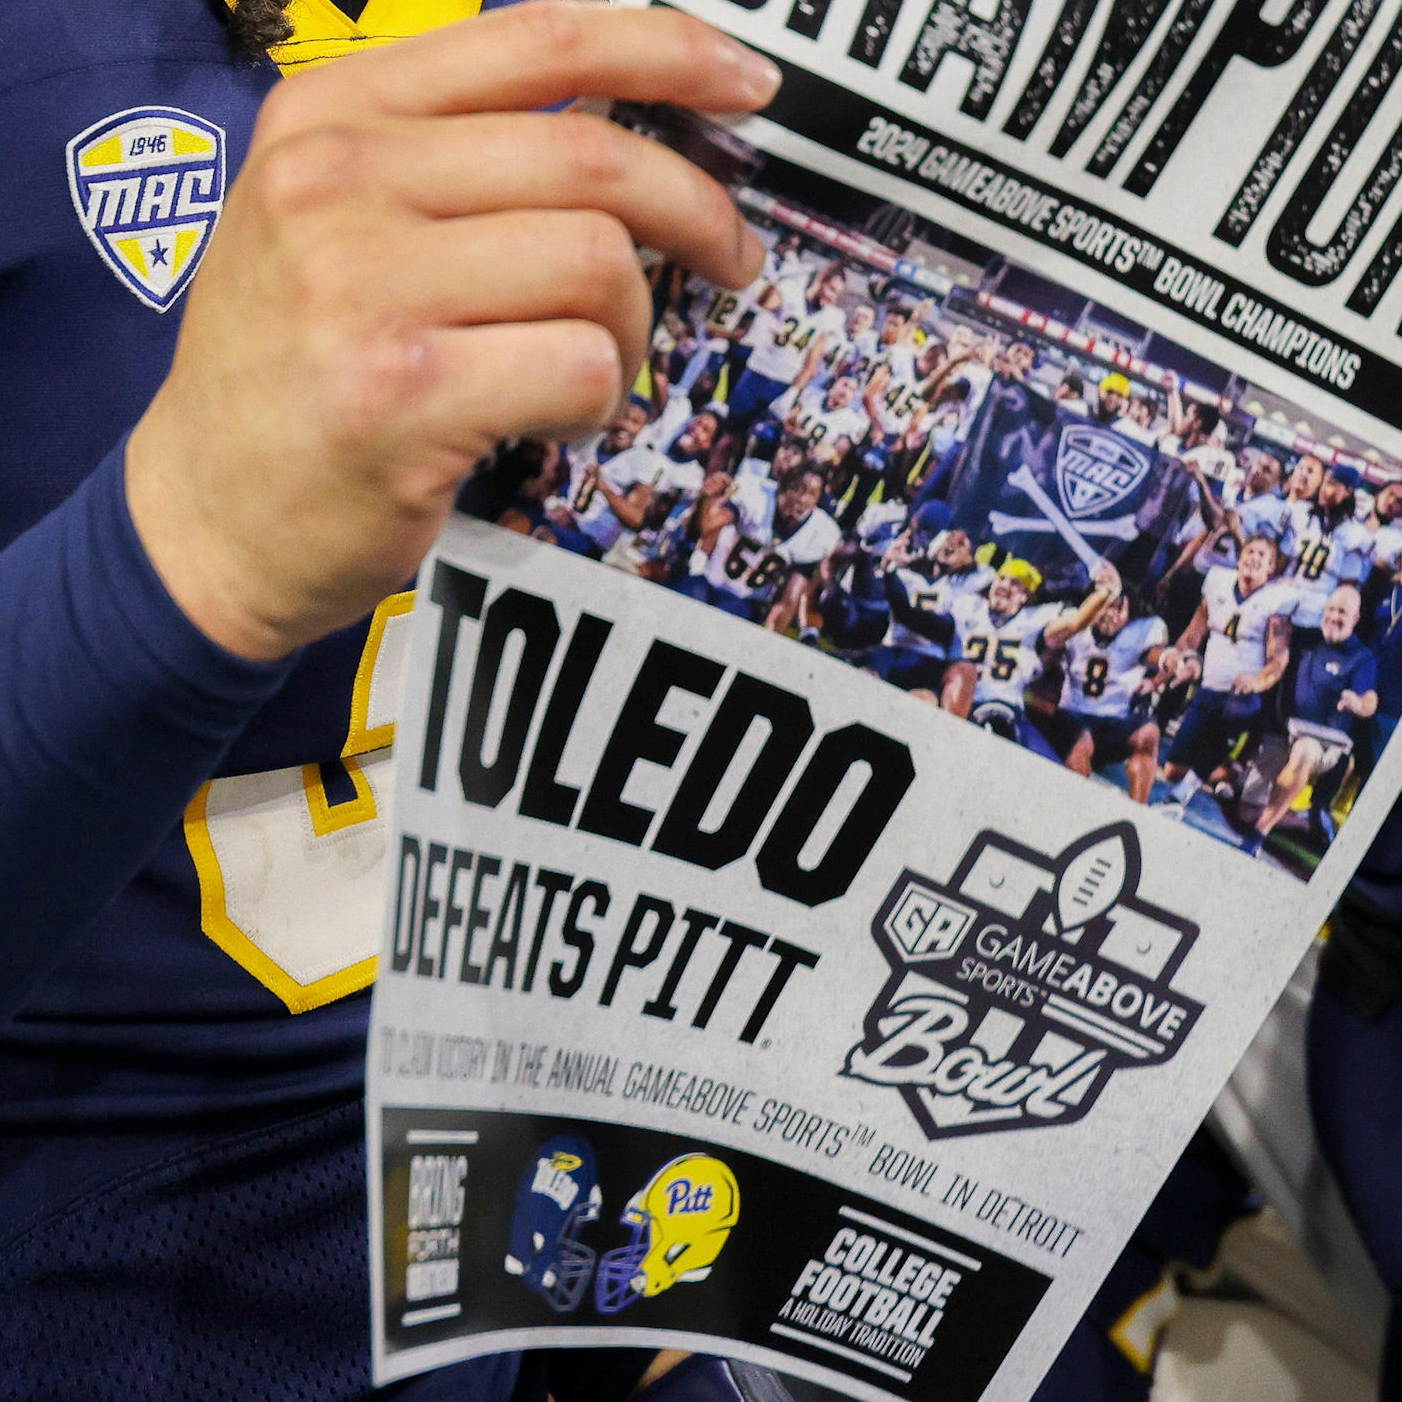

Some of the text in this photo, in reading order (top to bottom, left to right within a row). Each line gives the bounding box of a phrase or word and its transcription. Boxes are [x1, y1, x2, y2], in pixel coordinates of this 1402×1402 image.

[129, 134, 167, 156] 1946
[85, 168, 224, 231] MAC
[857, 116, 919, 171] 2024
[918, 144, 1056, 231] GAMEABOVE
[1153, 258, 1226, 323] BOWL
[1220, 297, 1362, 392] CHAMPIONS
[1082, 653, 1109, 698] 8
[418, 557, 917, 908] TOLEDO
[389, 833, 611, 999] DEFEATS
[974, 922, 1189, 1042] GAMEABOVE
[843, 995, 1107, 1118] Bowl
[513, 1041, 550, 1088] THE
[546, 1047, 620, 1098] ANNUAL
[621, 1060, 757, 1127] GAMEABOVE
[867, 1143, 940, 1198] BOWL
[940, 1173, 980, 1212] IN
[975, 1188, 1086, 1259] DETROIT
[664, 1178, 714, 1217] Pitt
[790, 1258, 945, 1350] FOOTBALL
[823, 1225, 963, 1309] COLLEGE
[778, 1296, 928, 1370] A HOLIDAY TRADITION
